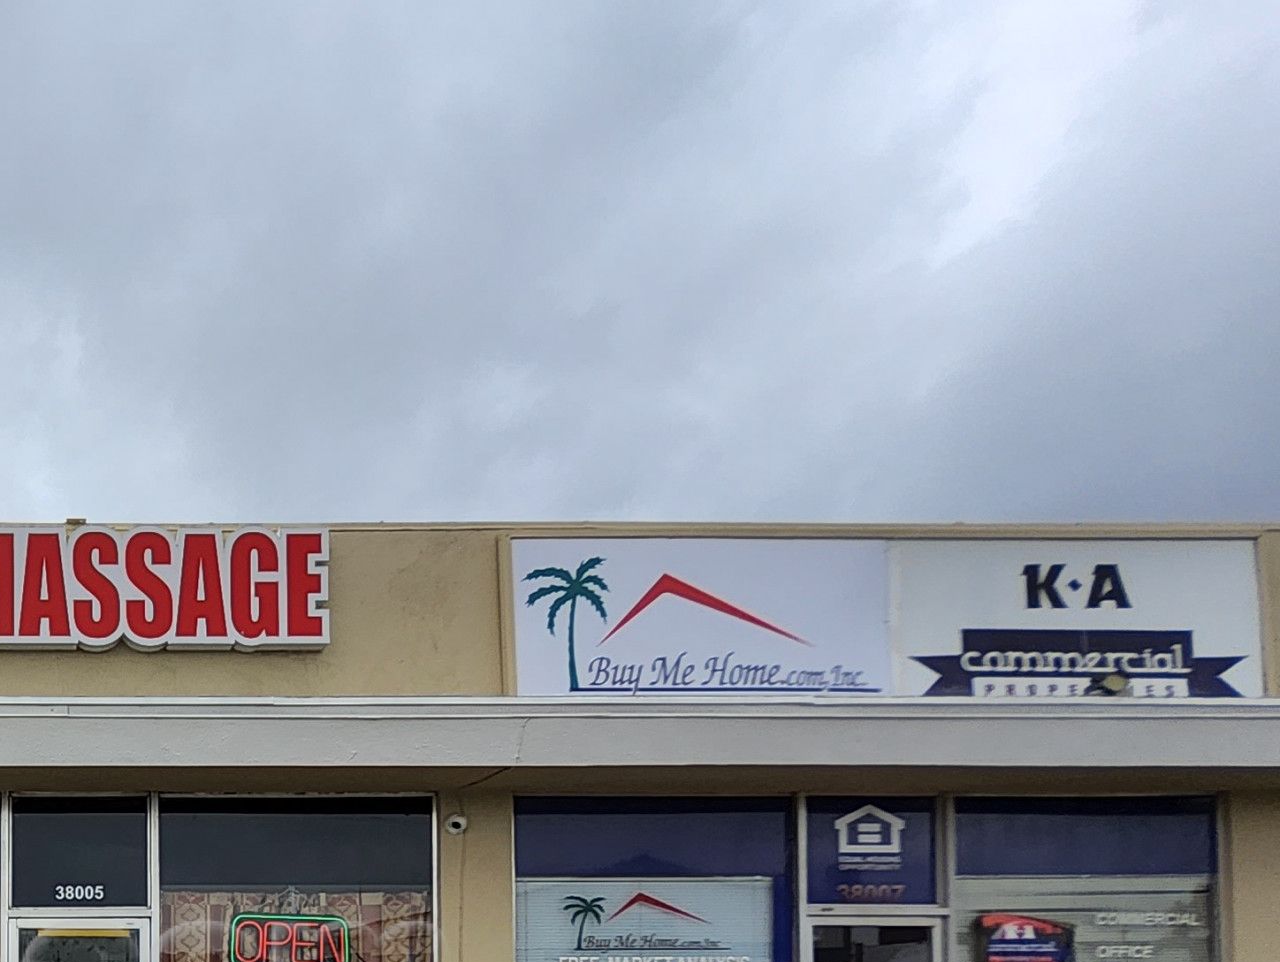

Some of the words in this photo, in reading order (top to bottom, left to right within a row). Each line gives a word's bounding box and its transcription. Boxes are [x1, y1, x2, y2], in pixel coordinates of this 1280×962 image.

[960, 644, 1192, 672] commercial
[588, 656, 643, 695] Buy
[649, 652, 694, 686] Me
[55, 886, 104, 899] 38005
[584, 936, 611, 953] Buy
[614, 933, 637, 947] Me
[1096, 946, 1154, 958] OFFICE
